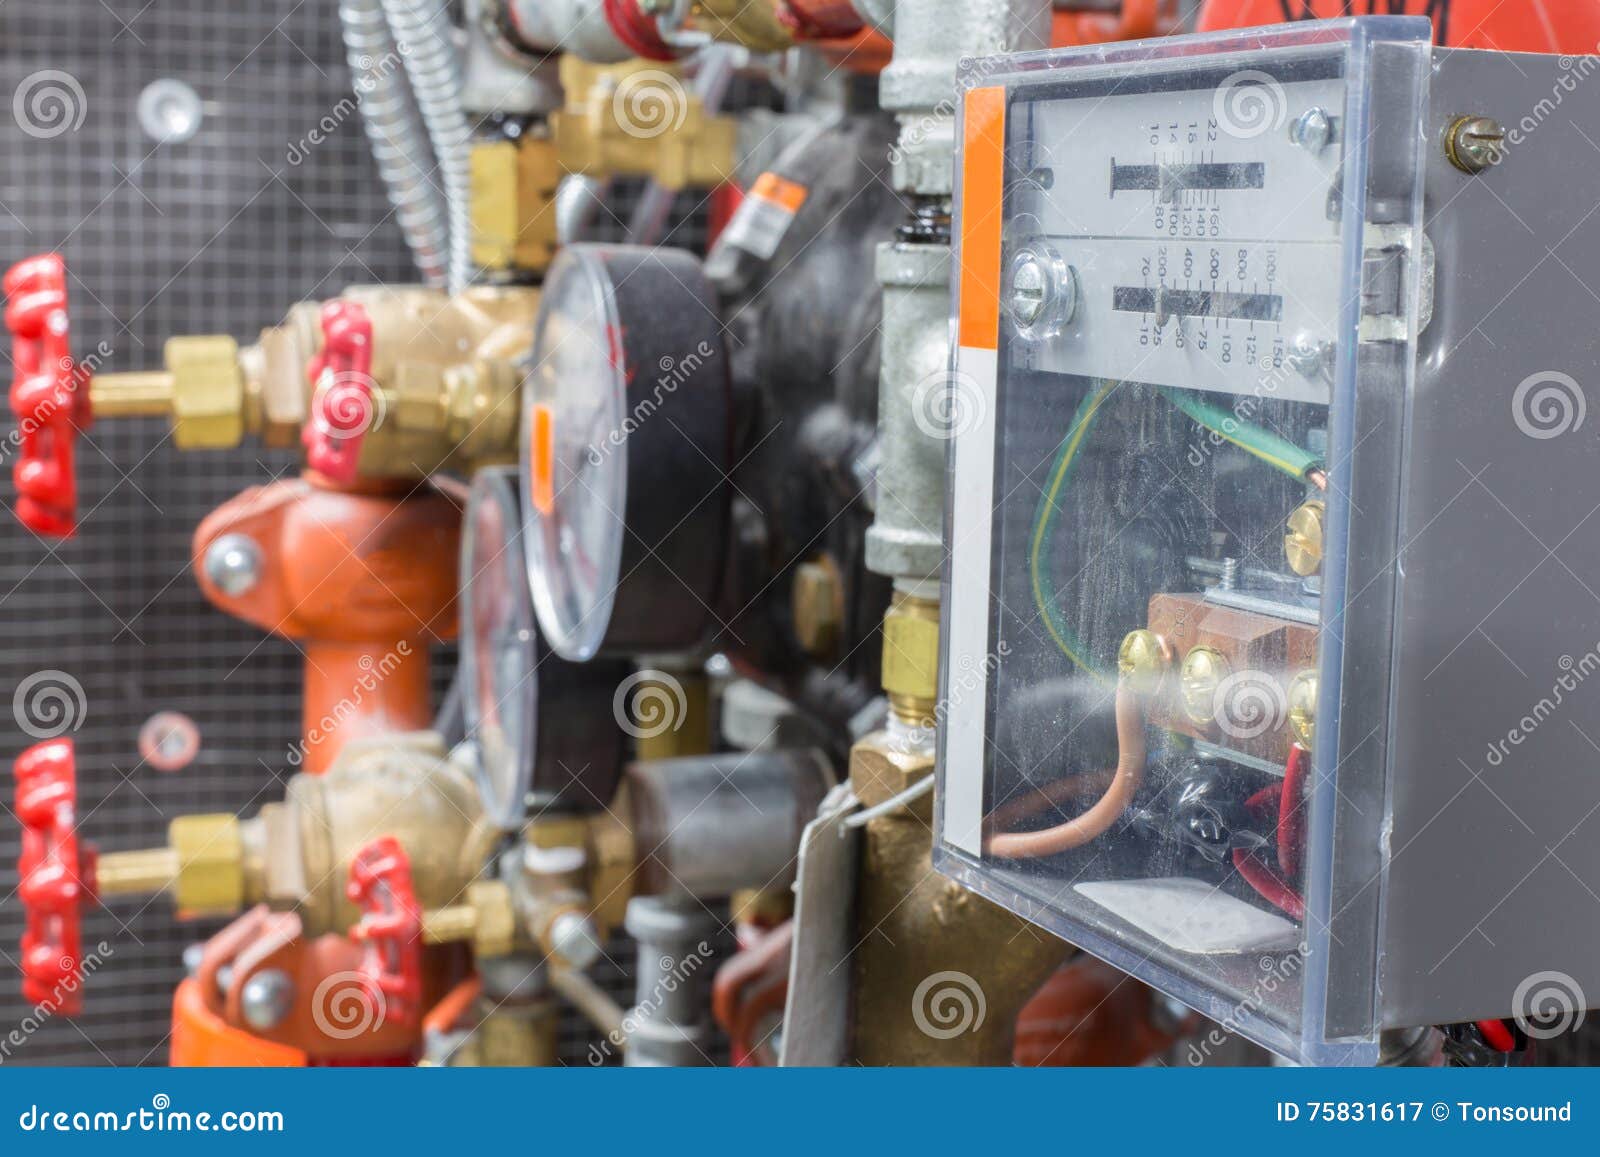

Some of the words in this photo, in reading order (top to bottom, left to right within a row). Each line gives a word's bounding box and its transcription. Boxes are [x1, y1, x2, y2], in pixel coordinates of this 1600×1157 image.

[1150, 123, 1160, 145] 10
[1207, 117, 1218, 142] 22
[1155, 206, 1164, 229] 80
[1169, 207, 1179, 236] 100
[1196, 207, 1206, 236] 140
[1210, 206, 1220, 237] 160
[1141, 256, 1151, 277] 70
[1158, 248, 1168, 277] 200
[1183, 248, 1193, 278] 400
[1236, 249, 1248, 281] 800
[1139, 327, 1149, 346] 10
[1152, 325, 1163, 347] 25
[1198, 329, 1208, 351] 75
[1221, 335, 1232, 364] 100
[1246, 335, 1257, 366] 125
[1272, 338, 1284, 369] 150
